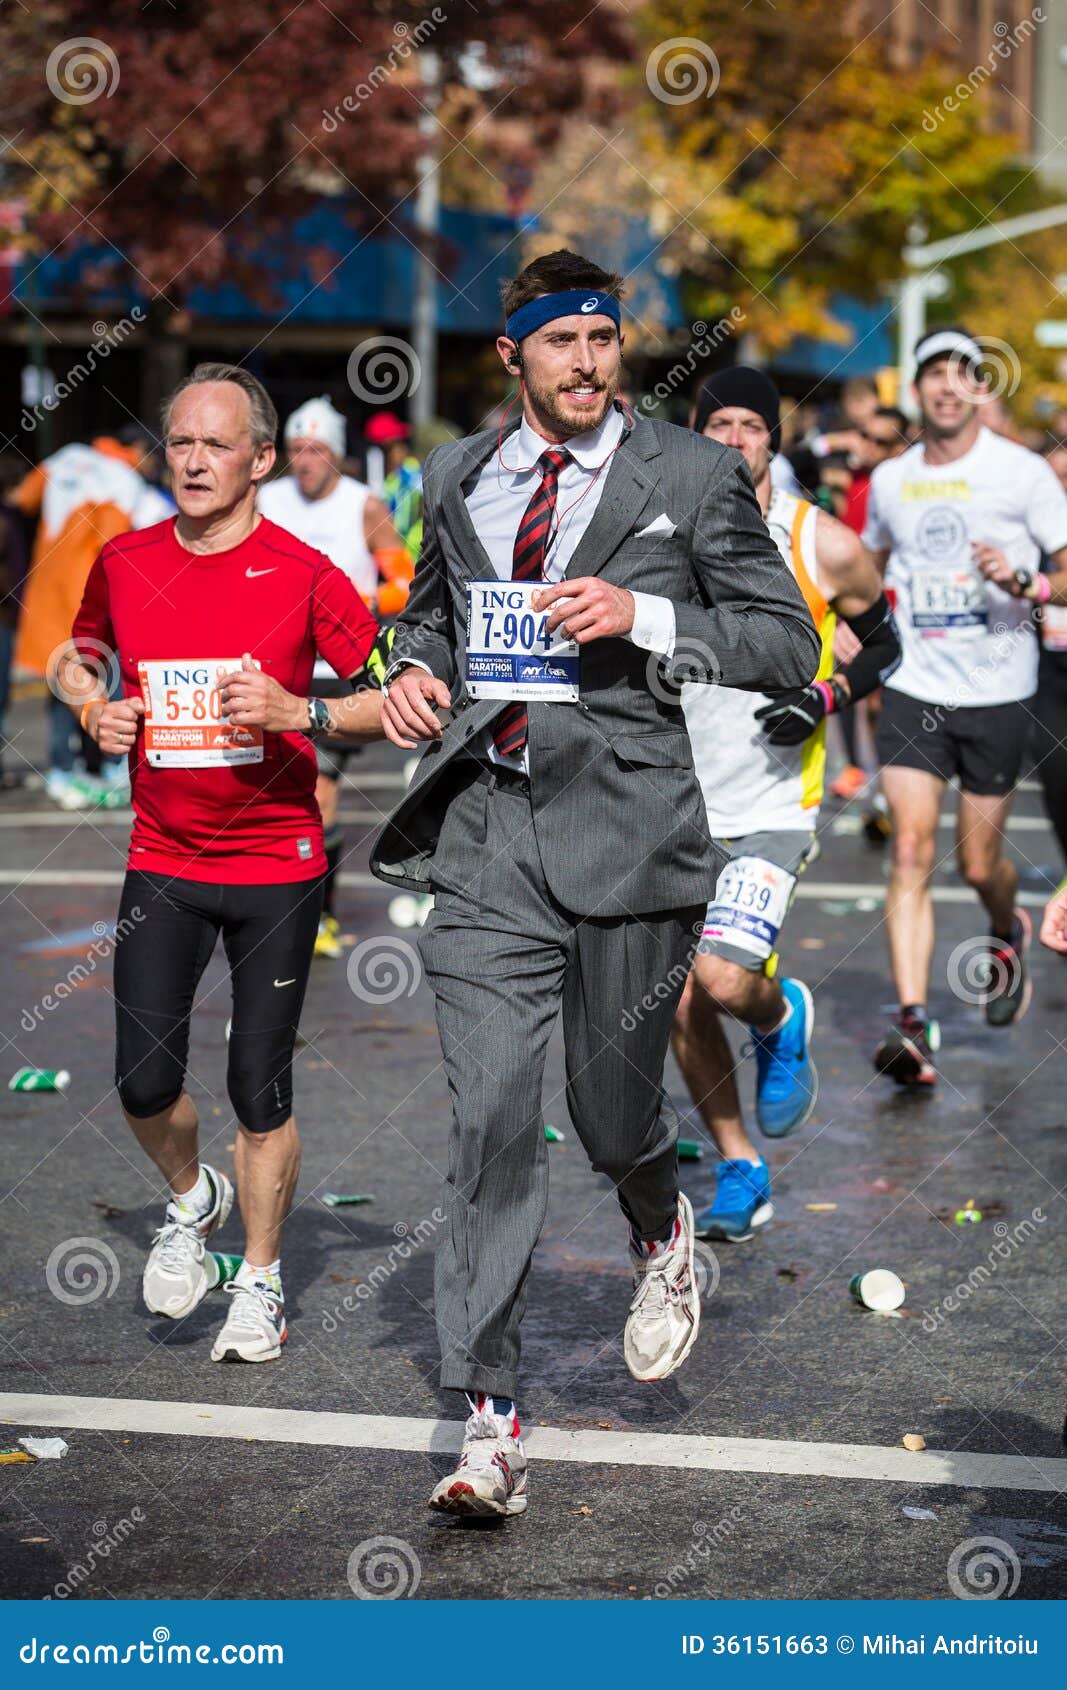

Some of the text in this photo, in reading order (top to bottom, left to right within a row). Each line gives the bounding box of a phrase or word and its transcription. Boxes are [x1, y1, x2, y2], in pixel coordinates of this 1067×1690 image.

[482, 590, 525, 609] ING
[482, 612, 554, 651] 7-904
[469, 662, 512, 672] MARATHON
[163, 668, 209, 686] ING
